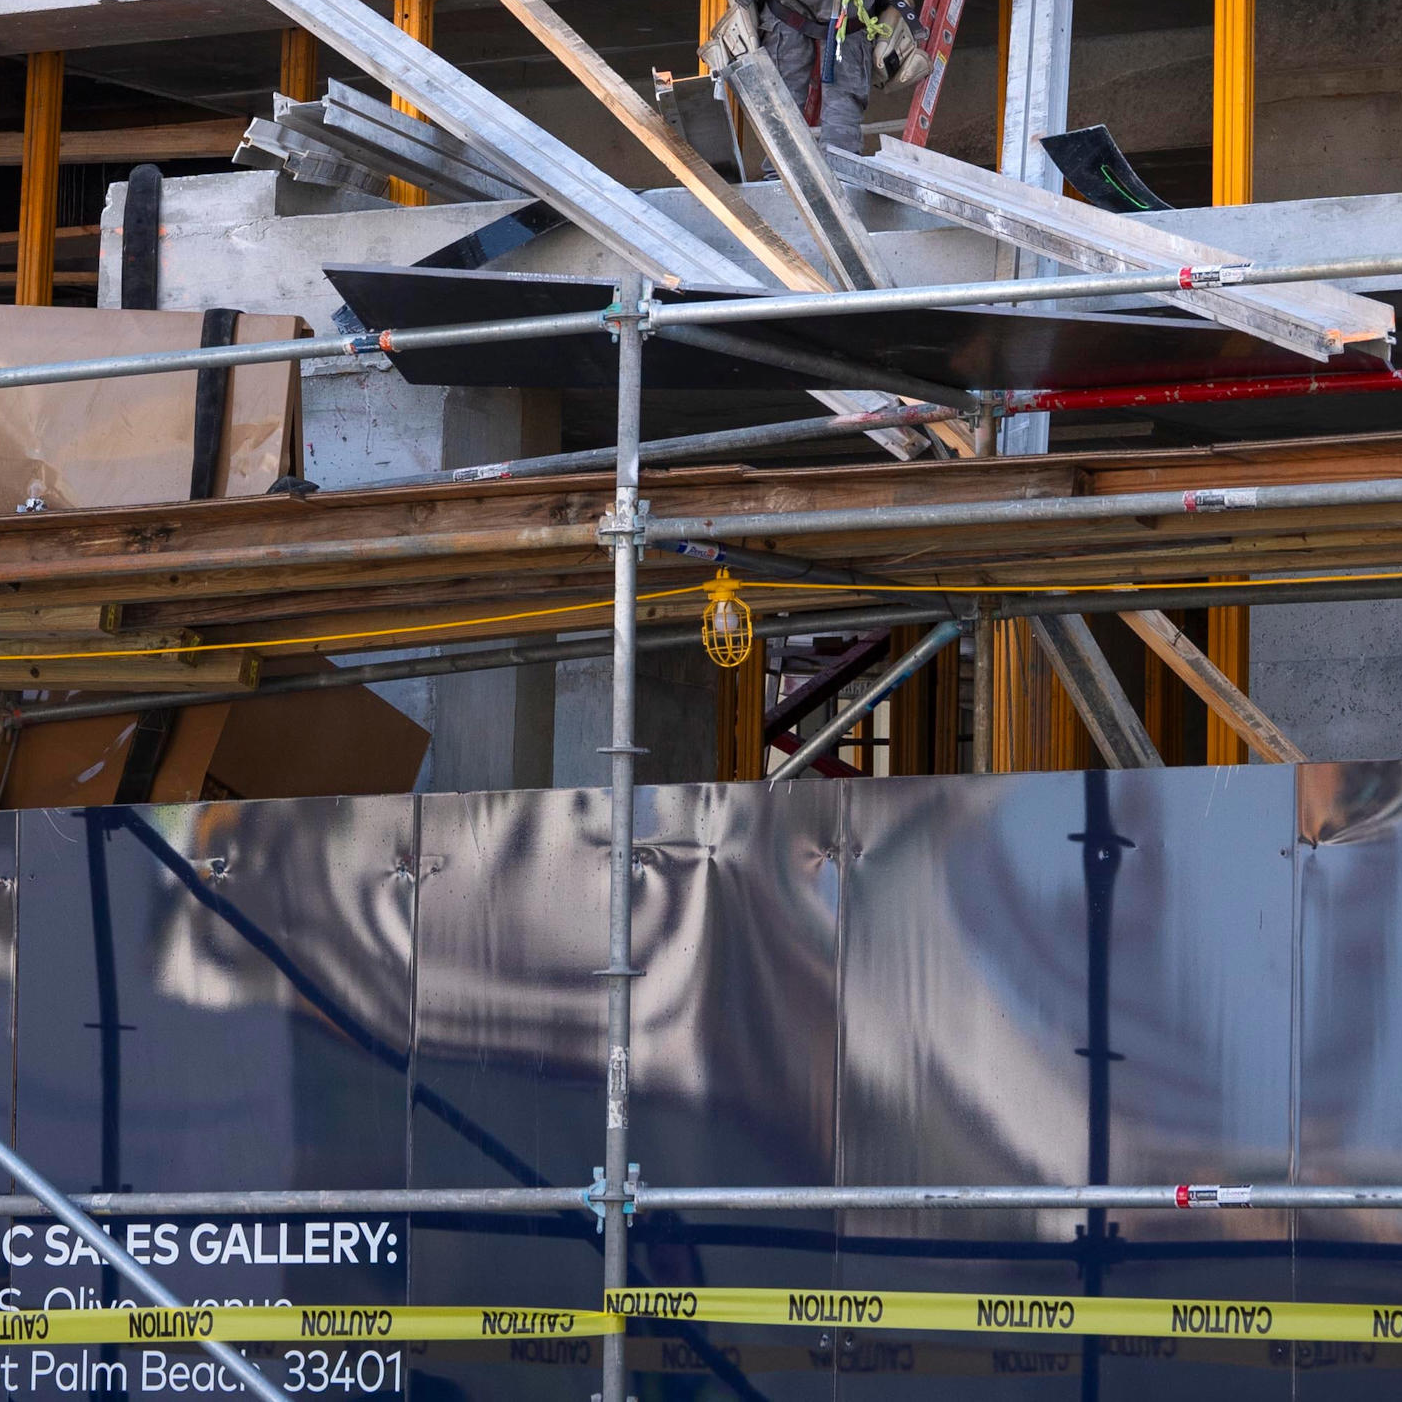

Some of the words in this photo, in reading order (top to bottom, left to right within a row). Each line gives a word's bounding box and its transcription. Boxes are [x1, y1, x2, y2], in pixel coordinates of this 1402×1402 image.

[2, 1225, 34, 1266] C
[189, 1222, 397, 1265] GALLERY:
[129, 1310, 213, 1338] CAUTION
[302, 1310, 393, 1337] CAUTION
[482, 1311, 575, 1335] CAUTION
[607, 1291, 697, 1317] CAUTION
[789, 1294, 883, 1323] CAUTION
[978, 1299, 1074, 1328] CAUTION
[1172, 1304, 1272, 1334] CAUTION
[31, 1349, 127, 1391] Palm
[283, 1350, 401, 1392] 33401
